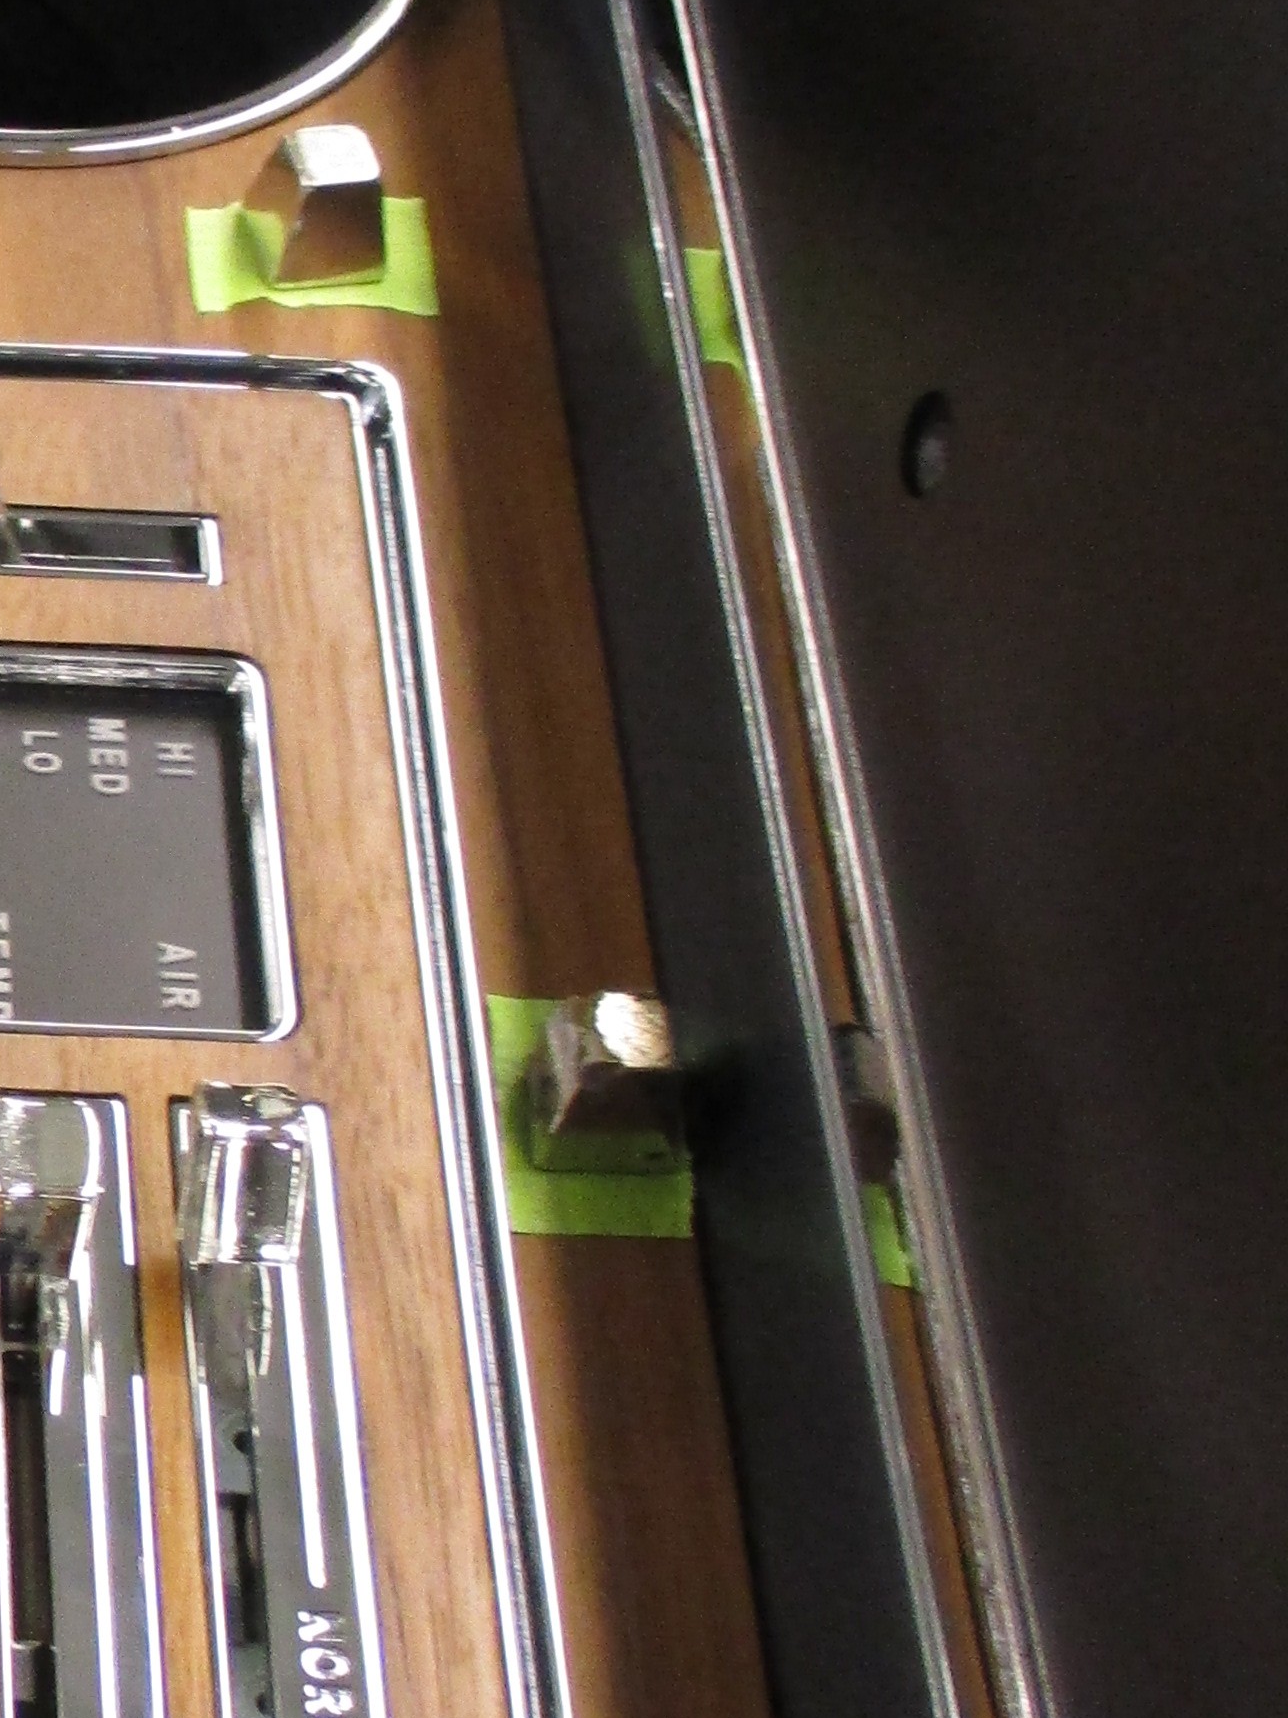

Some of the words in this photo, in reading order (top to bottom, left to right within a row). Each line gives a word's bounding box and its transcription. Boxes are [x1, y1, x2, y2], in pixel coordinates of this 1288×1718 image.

[22, 730, 64, 774] LO
[87, 718, 130, 796] MED
[156, 741, 196, 777] HI
[158, 941, 202, 1010] AIR
